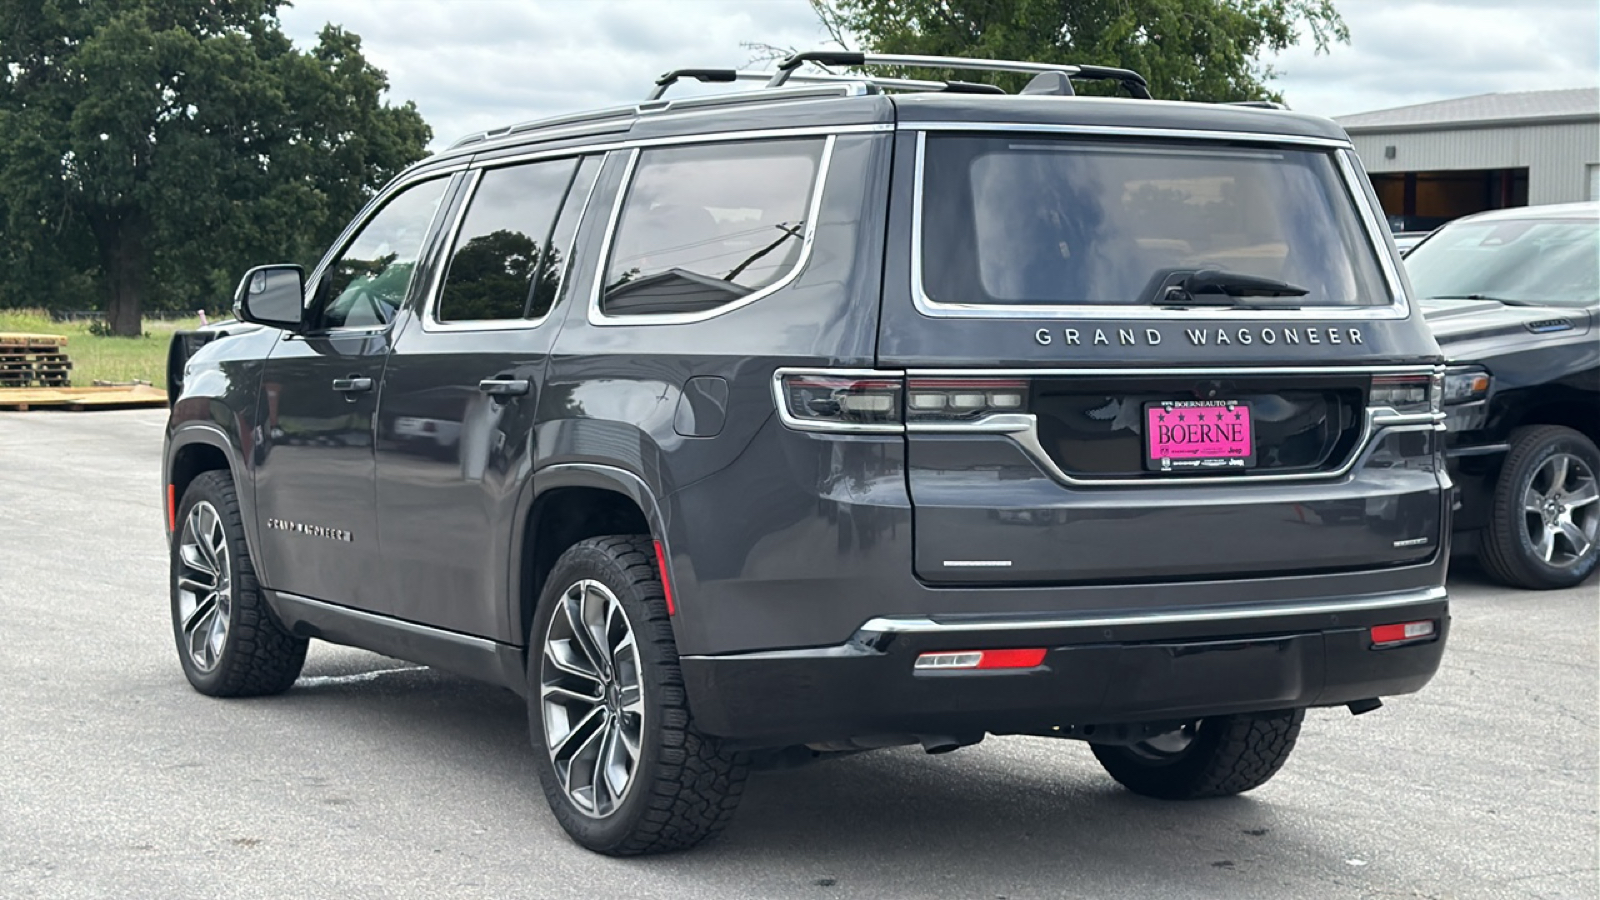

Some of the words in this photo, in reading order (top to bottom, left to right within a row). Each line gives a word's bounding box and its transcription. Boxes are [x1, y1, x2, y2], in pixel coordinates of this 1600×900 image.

[1035, 328, 1161, 345] GRAND
[1186, 328, 1363, 345] WAGONEER
[1158, 423, 1245, 445] BOERNE
